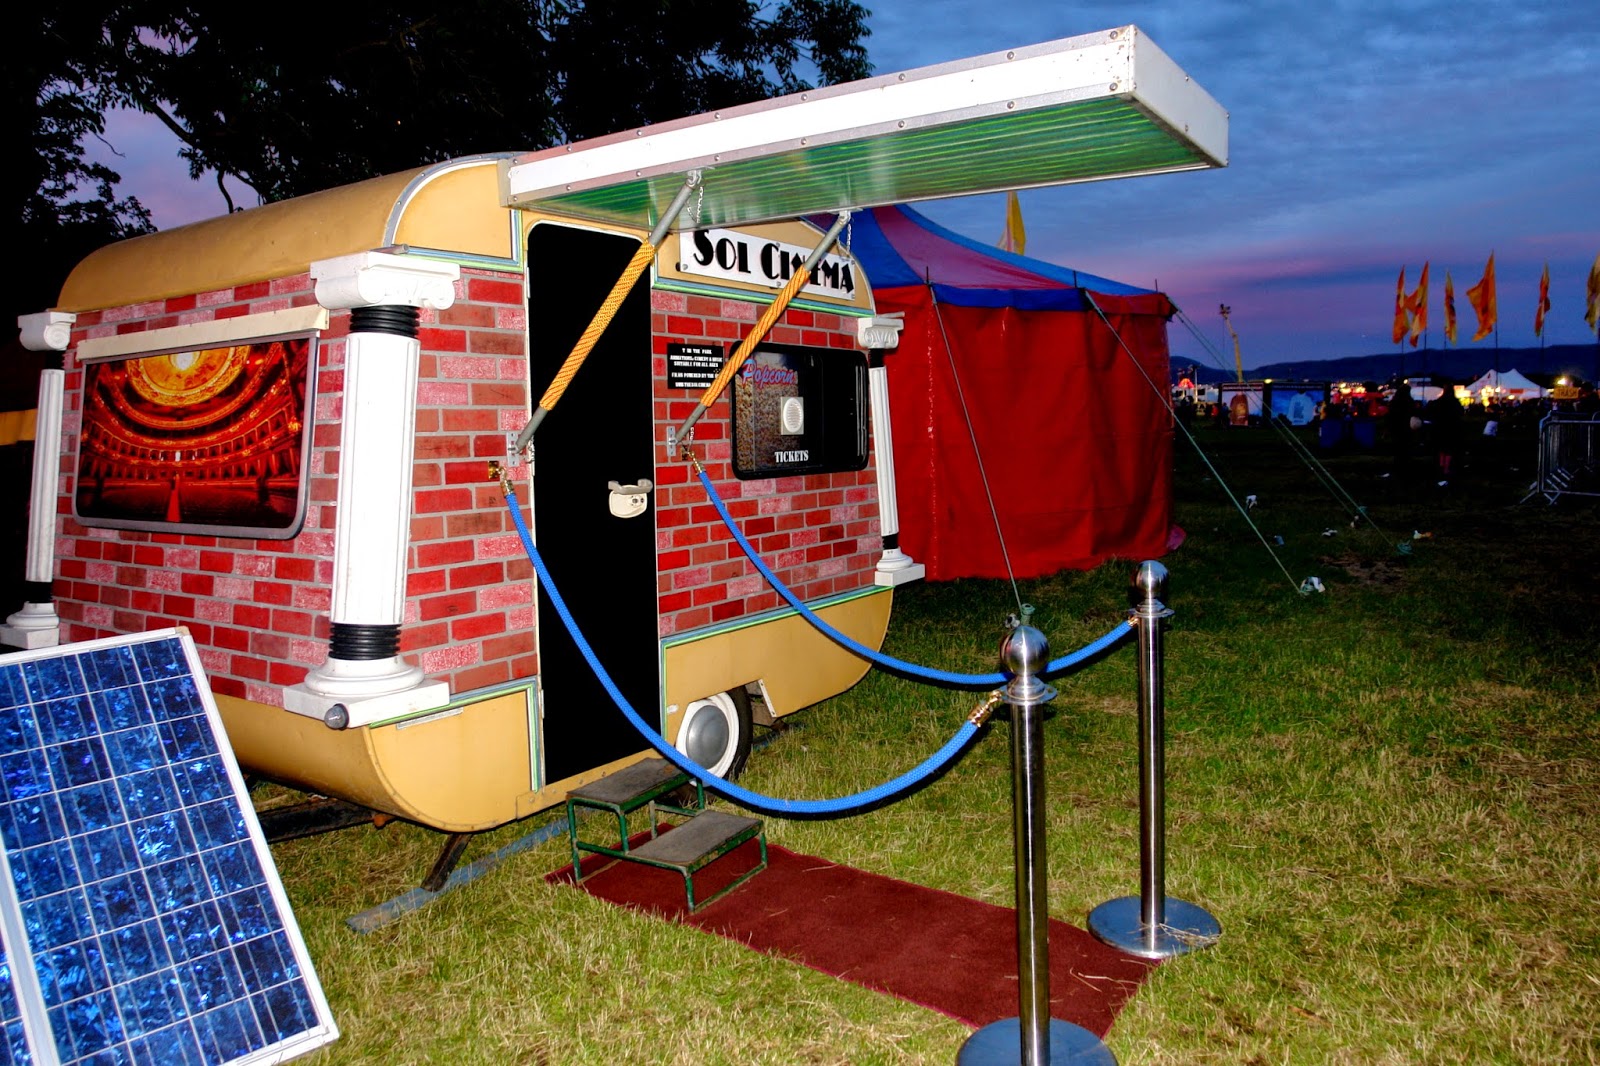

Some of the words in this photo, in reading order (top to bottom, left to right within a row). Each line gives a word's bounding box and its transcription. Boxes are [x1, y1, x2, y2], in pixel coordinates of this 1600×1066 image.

[693, 229, 751, 274] SOL
[743, 359, 795, 388] Popcorn
[774, 450, 809, 463] TICKETS
